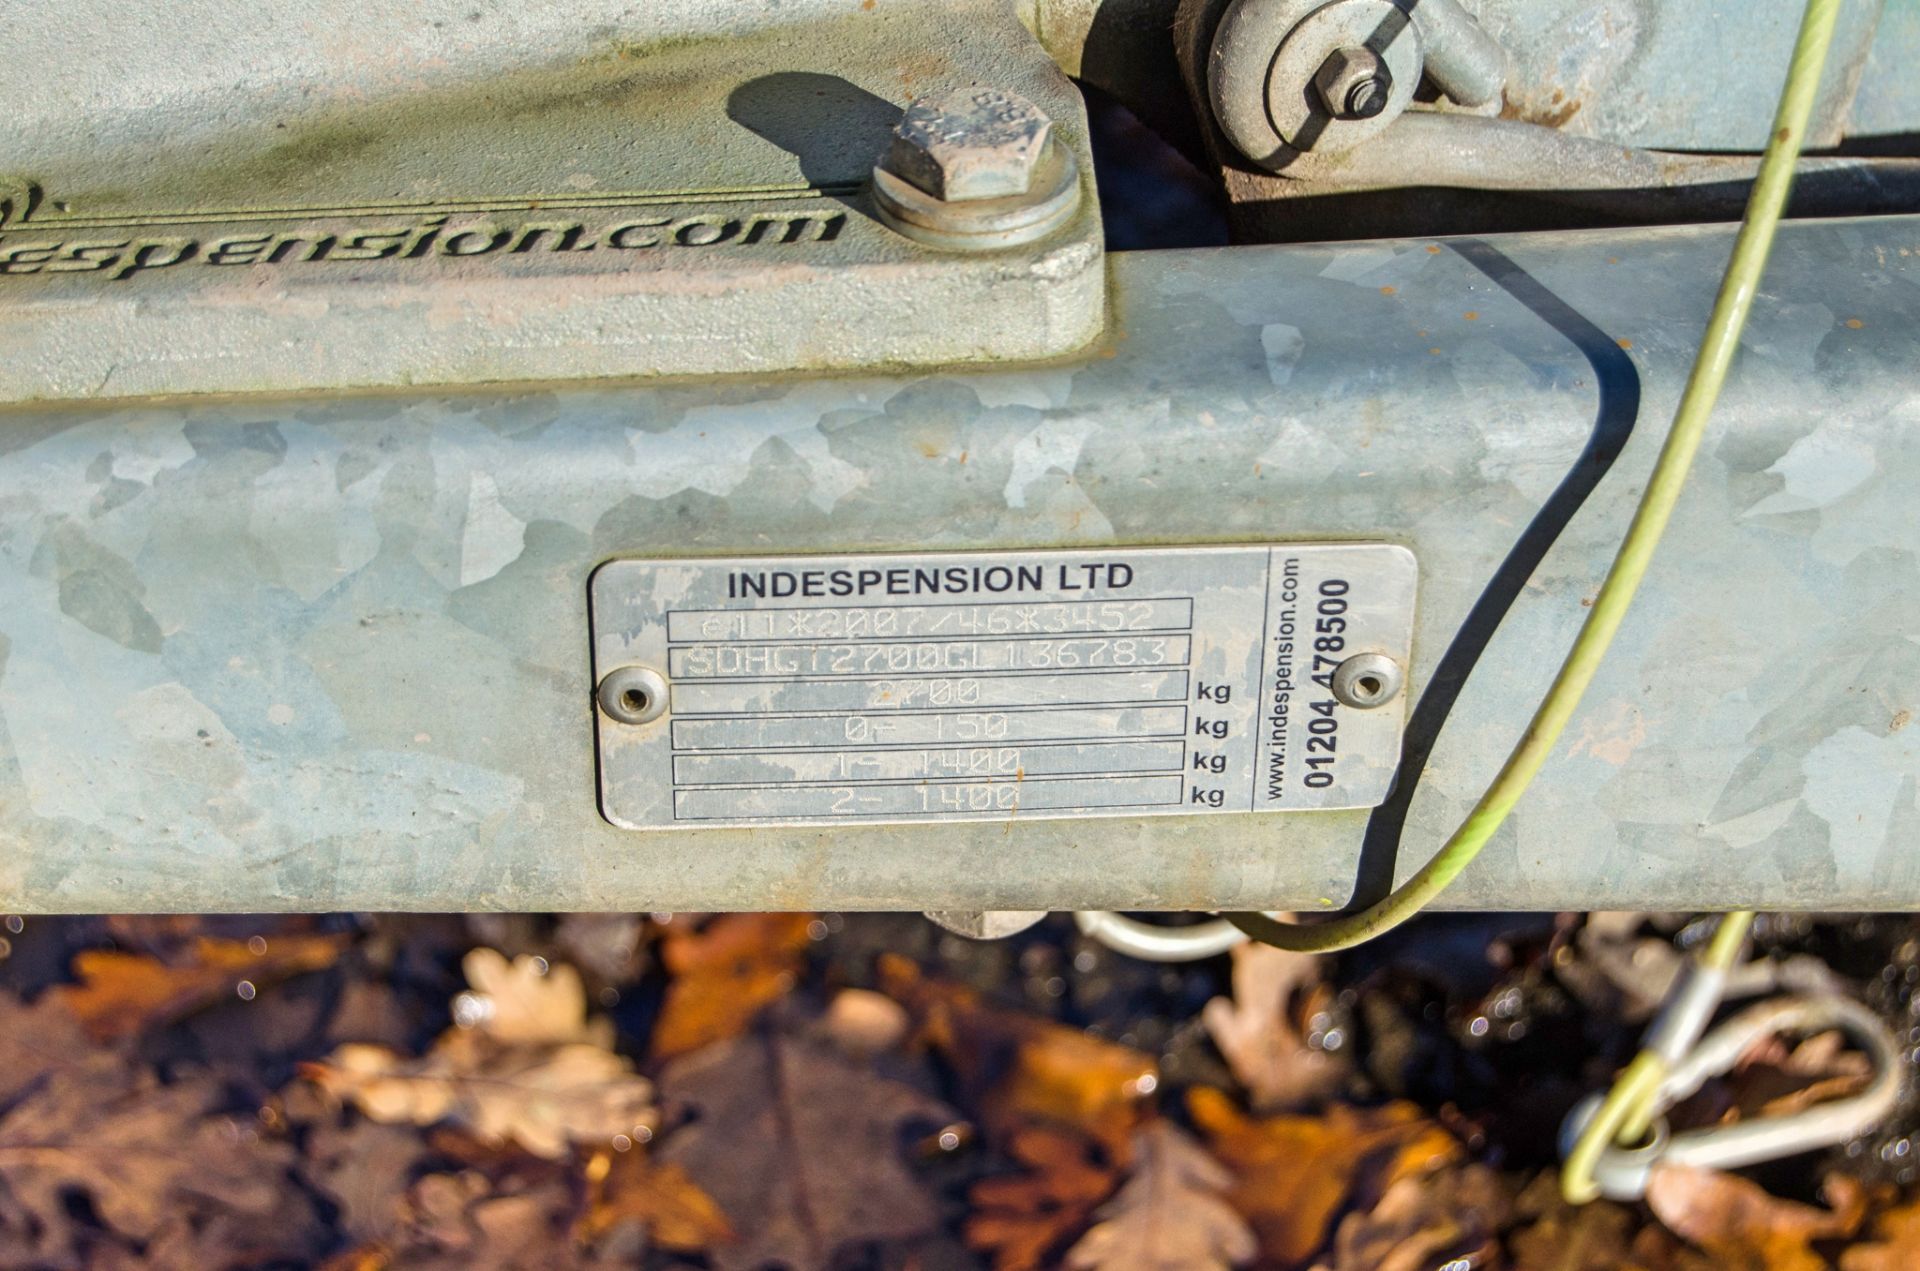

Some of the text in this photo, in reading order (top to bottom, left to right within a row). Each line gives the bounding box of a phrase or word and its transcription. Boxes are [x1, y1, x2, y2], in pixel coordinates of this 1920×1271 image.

[0, 209, 846, 280] espension.com
[728, 563, 1134, 599] INDESPENSION LTD
[686, 638, 1166, 675] SDHGT2700GL136783
[871, 678, 1232, 707] 2700 kg
[1267, 557, 1300, 801] www.indespension.com
[933, 712, 1009, 740] 150
[1195, 716, 1229, 739] kg
[1304, 699, 1340, 788] 01204
[919, 747, 1021, 776] 1400
[1193, 751, 1227, 774] kg
[916, 783, 1021, 812] 1400
[1191, 785, 1226, 808] kg
